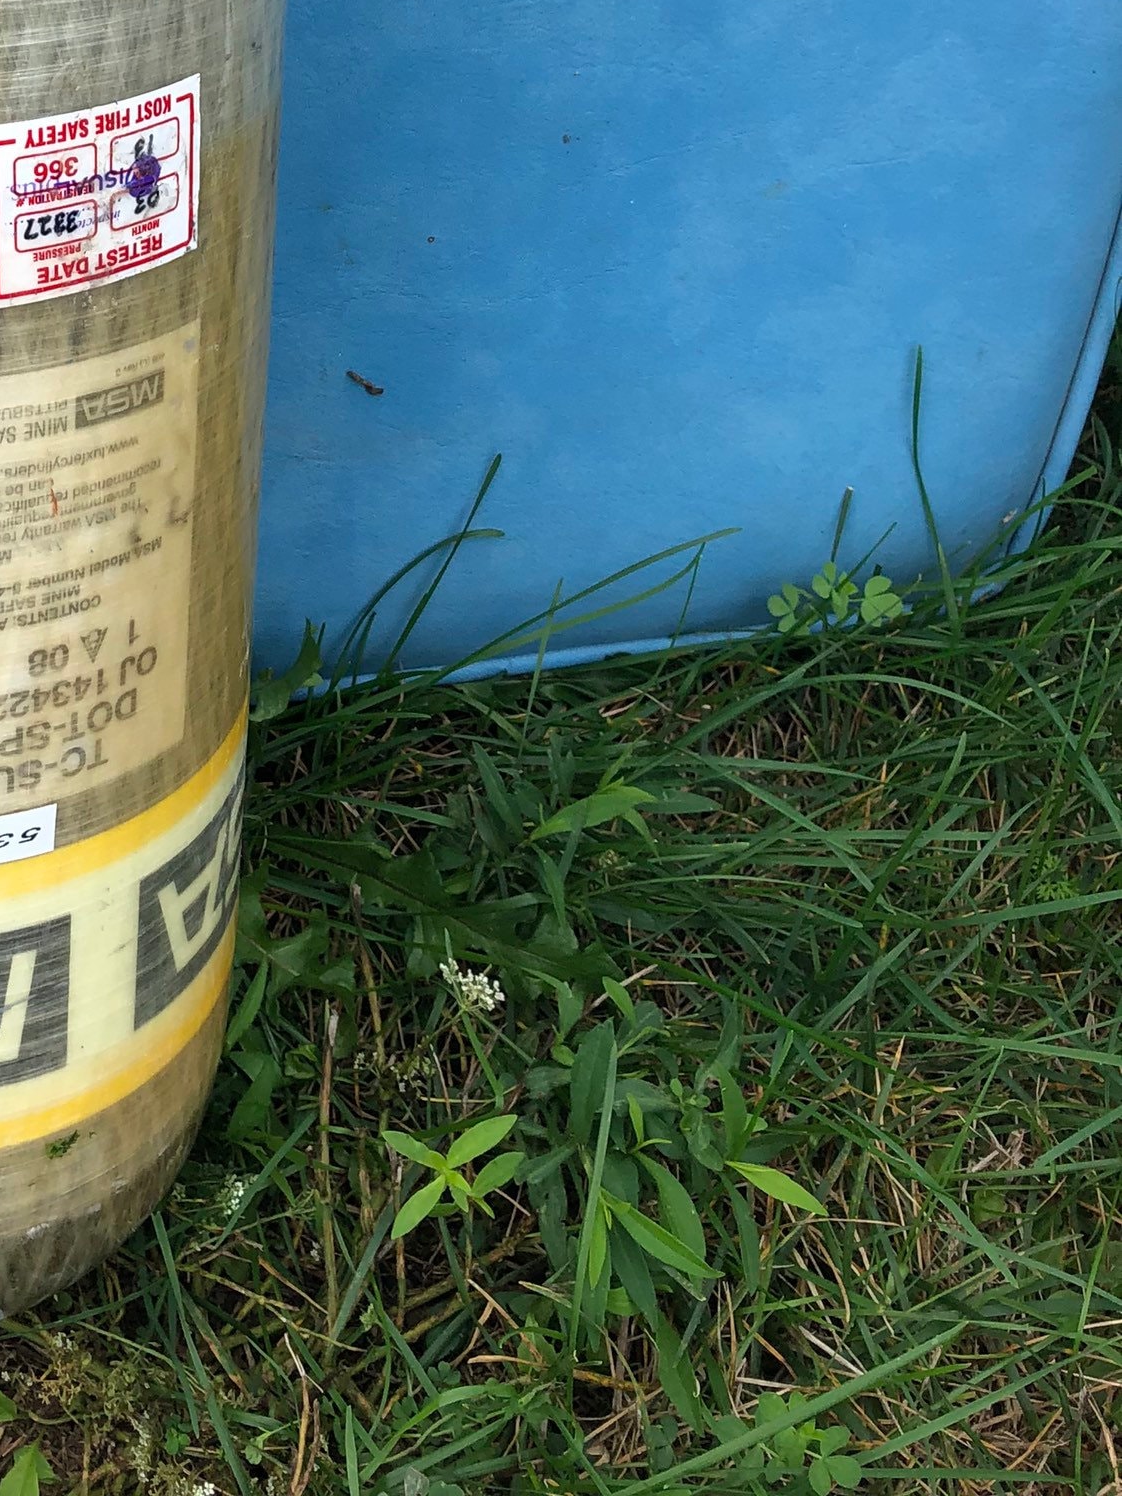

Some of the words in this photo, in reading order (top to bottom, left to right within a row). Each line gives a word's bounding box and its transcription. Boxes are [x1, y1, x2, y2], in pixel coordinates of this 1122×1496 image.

[95, 108, 130, 134] FIRE
[136, 94, 171, 123] KOST
[24, 118, 89, 148] SAFETY
[33, 156, 79, 183] 366
[132, 218, 160, 236] MONTH
[32, 242, 82, 262] PRESSURE
[94, 232, 162, 270] RETEST
[36, 256, 89, 284] DATE
[81, 374, 159, 421] MSA
[23, 416, 68, 442] MINE
[4, 483, 24, 498] be
[72, 458, 162, 498] recommended
[21, 517, 82, 542] warranty
[85, 510, 116, 526] MSA
[132, 536, 162, 558] MSA
[89, 550, 132, 573] Model
[27, 567, 86, 590] Number
[42, 584, 81, 606] MINE
[12, 594, 101, 628] CONTENTS:
[128, 618, 141, 646] 1
[27, 643, 70, 678] 08
[120, 646, 158, 686] OJ
